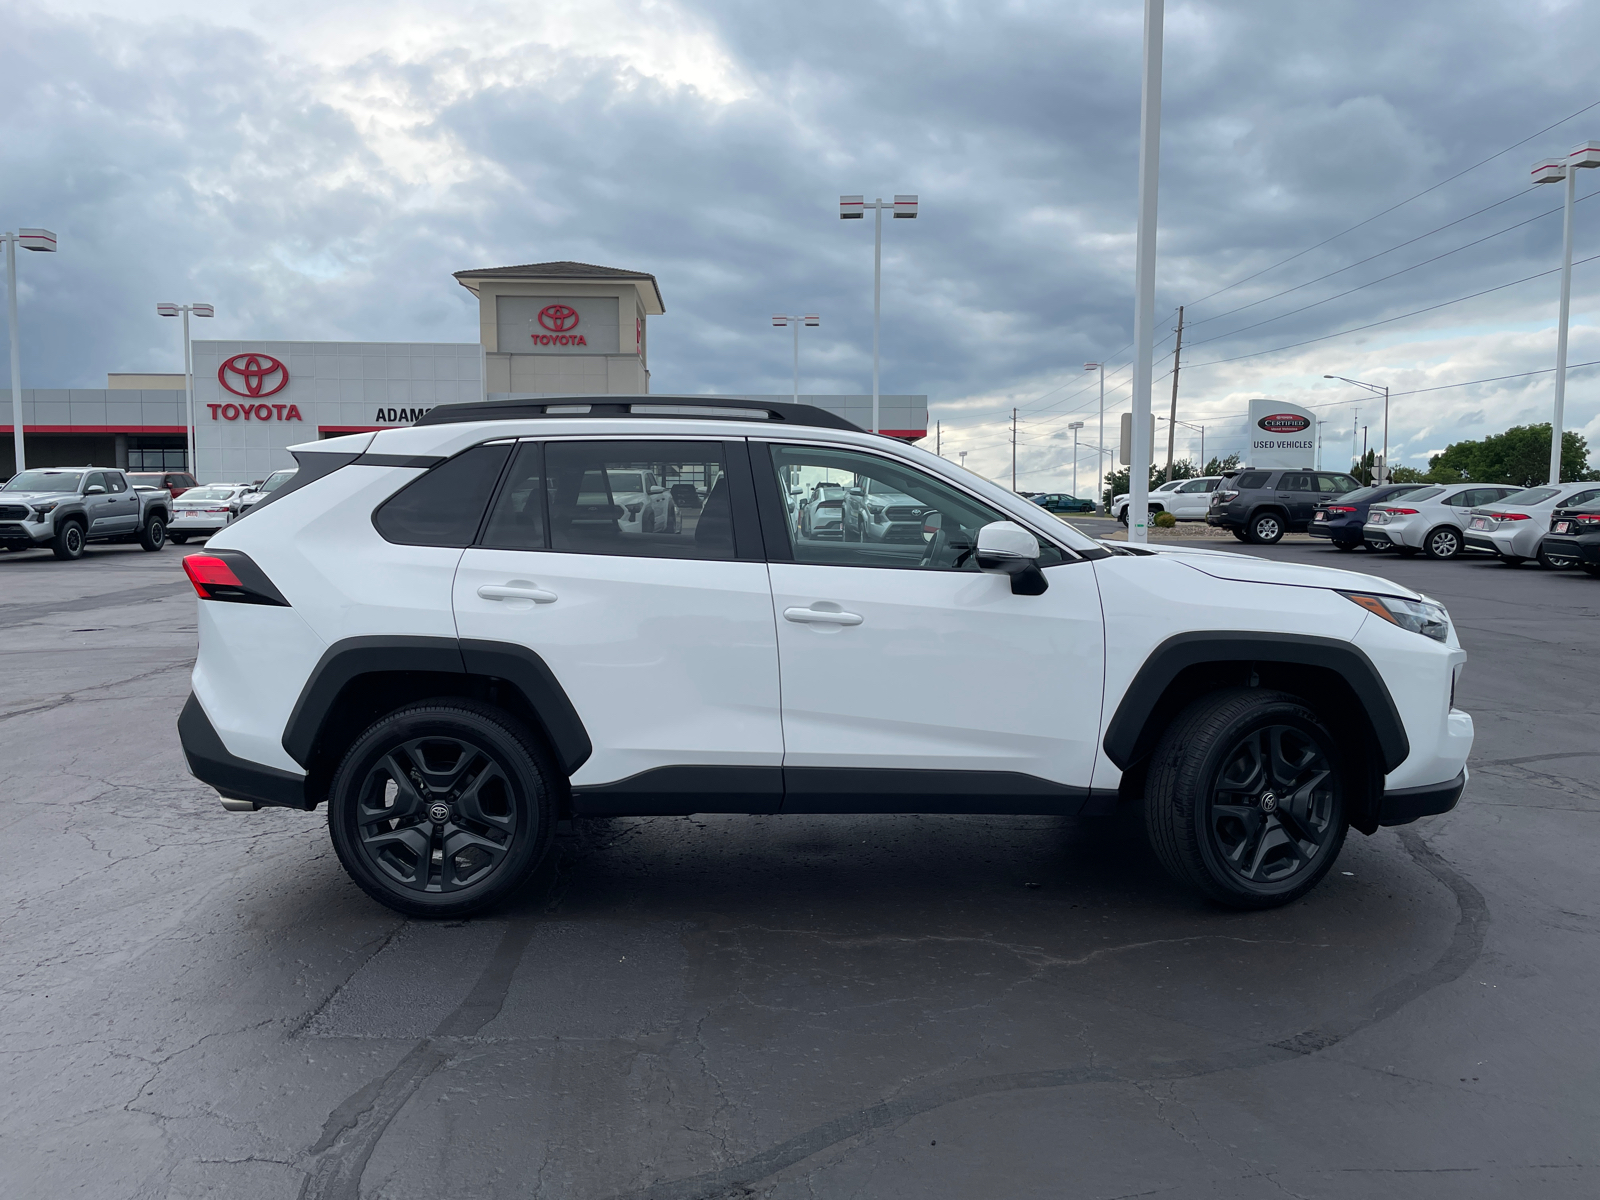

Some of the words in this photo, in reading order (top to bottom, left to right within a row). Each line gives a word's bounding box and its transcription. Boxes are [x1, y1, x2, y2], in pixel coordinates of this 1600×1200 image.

[531, 334, 587, 346] TOYOTA
[207, 403, 302, 421] TOYOTA
[376, 408, 432, 422] ADAM
[1253, 441, 1275, 449] USED
[1277, 441, 1313, 449] VEHICLES
